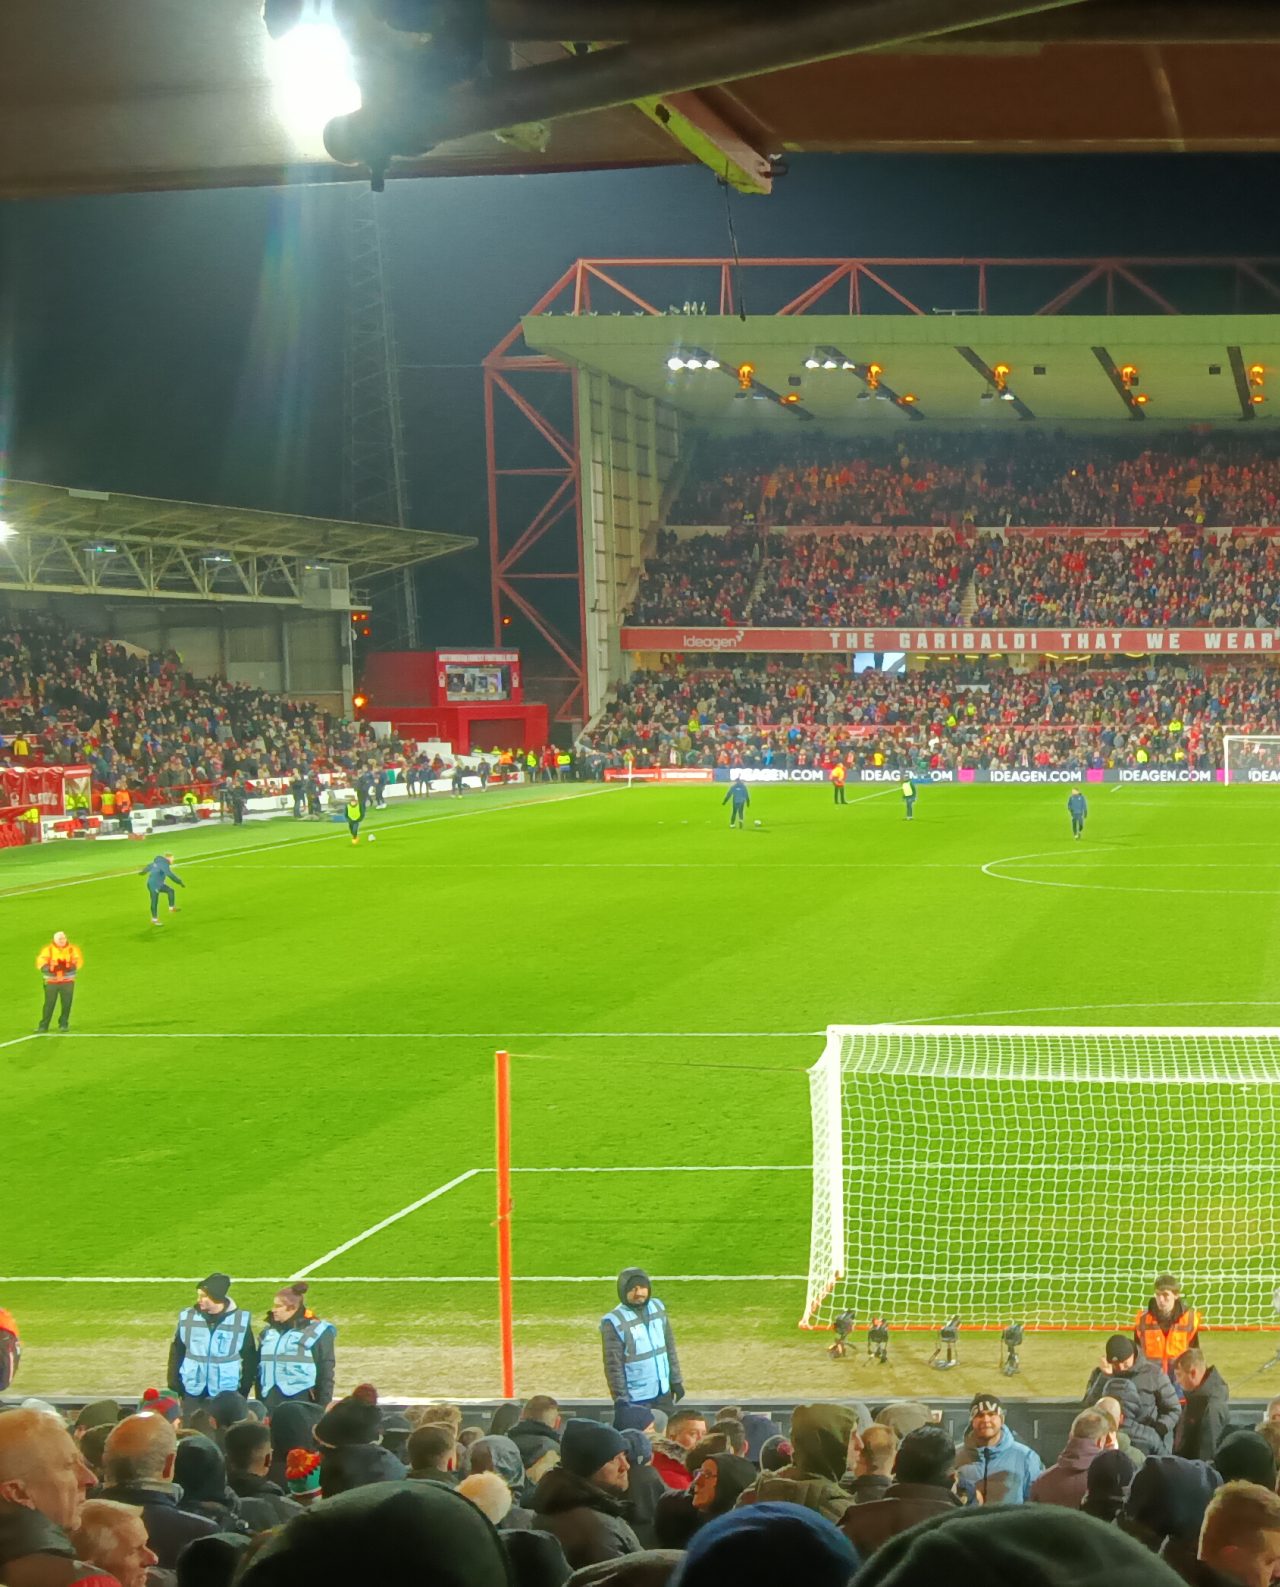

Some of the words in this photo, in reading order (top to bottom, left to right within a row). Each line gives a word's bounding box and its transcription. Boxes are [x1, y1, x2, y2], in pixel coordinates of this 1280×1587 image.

[829, 633, 874, 648] THE
[900, 633, 1037, 648] GARIBALDI
[1061, 633, 1122, 648] THAT
[1146, 633, 1180, 648] WE
[1204, 633, 1273, 648] WEAR
[990, 769, 1082, 782] IDEAGEN.COM
[1119, 769, 1211, 782] IDEAGEN.COM
